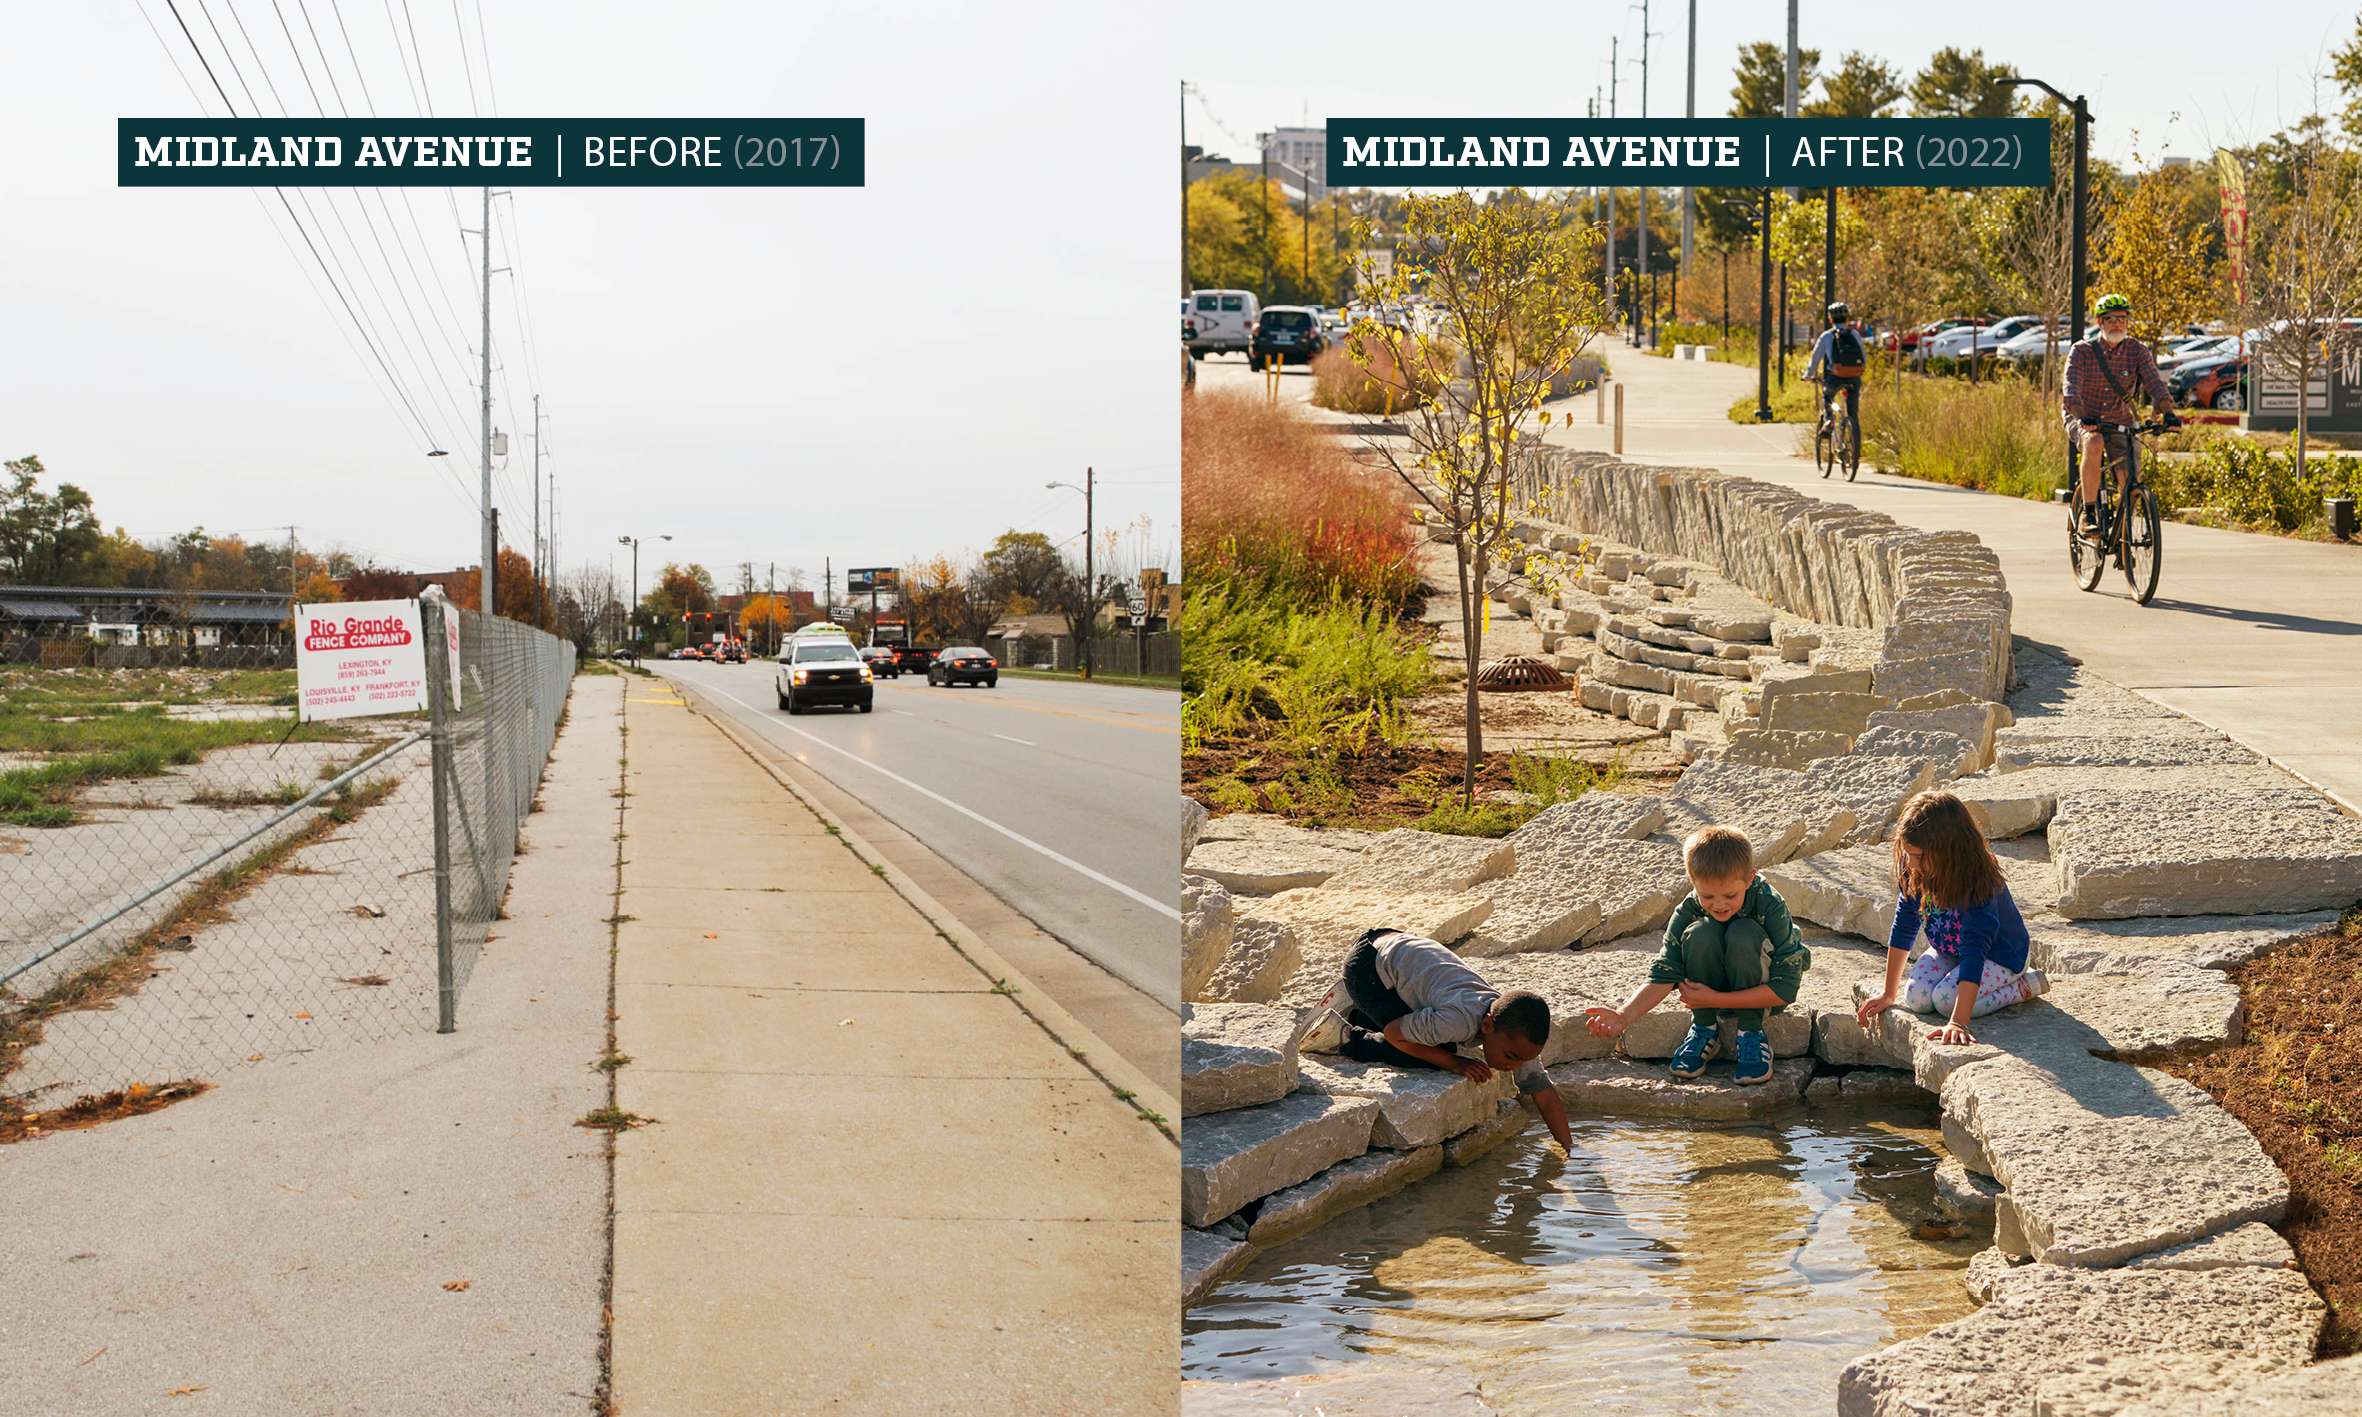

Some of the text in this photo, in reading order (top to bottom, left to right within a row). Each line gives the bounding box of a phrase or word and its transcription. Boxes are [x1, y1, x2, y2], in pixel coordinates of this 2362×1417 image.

[1132, 602, 1144, 611] 60
[310, 615, 403, 636] Rio Grande
[310, 632, 406, 649] FENCE COMPANY
[382, 659, 392, 667] KY
